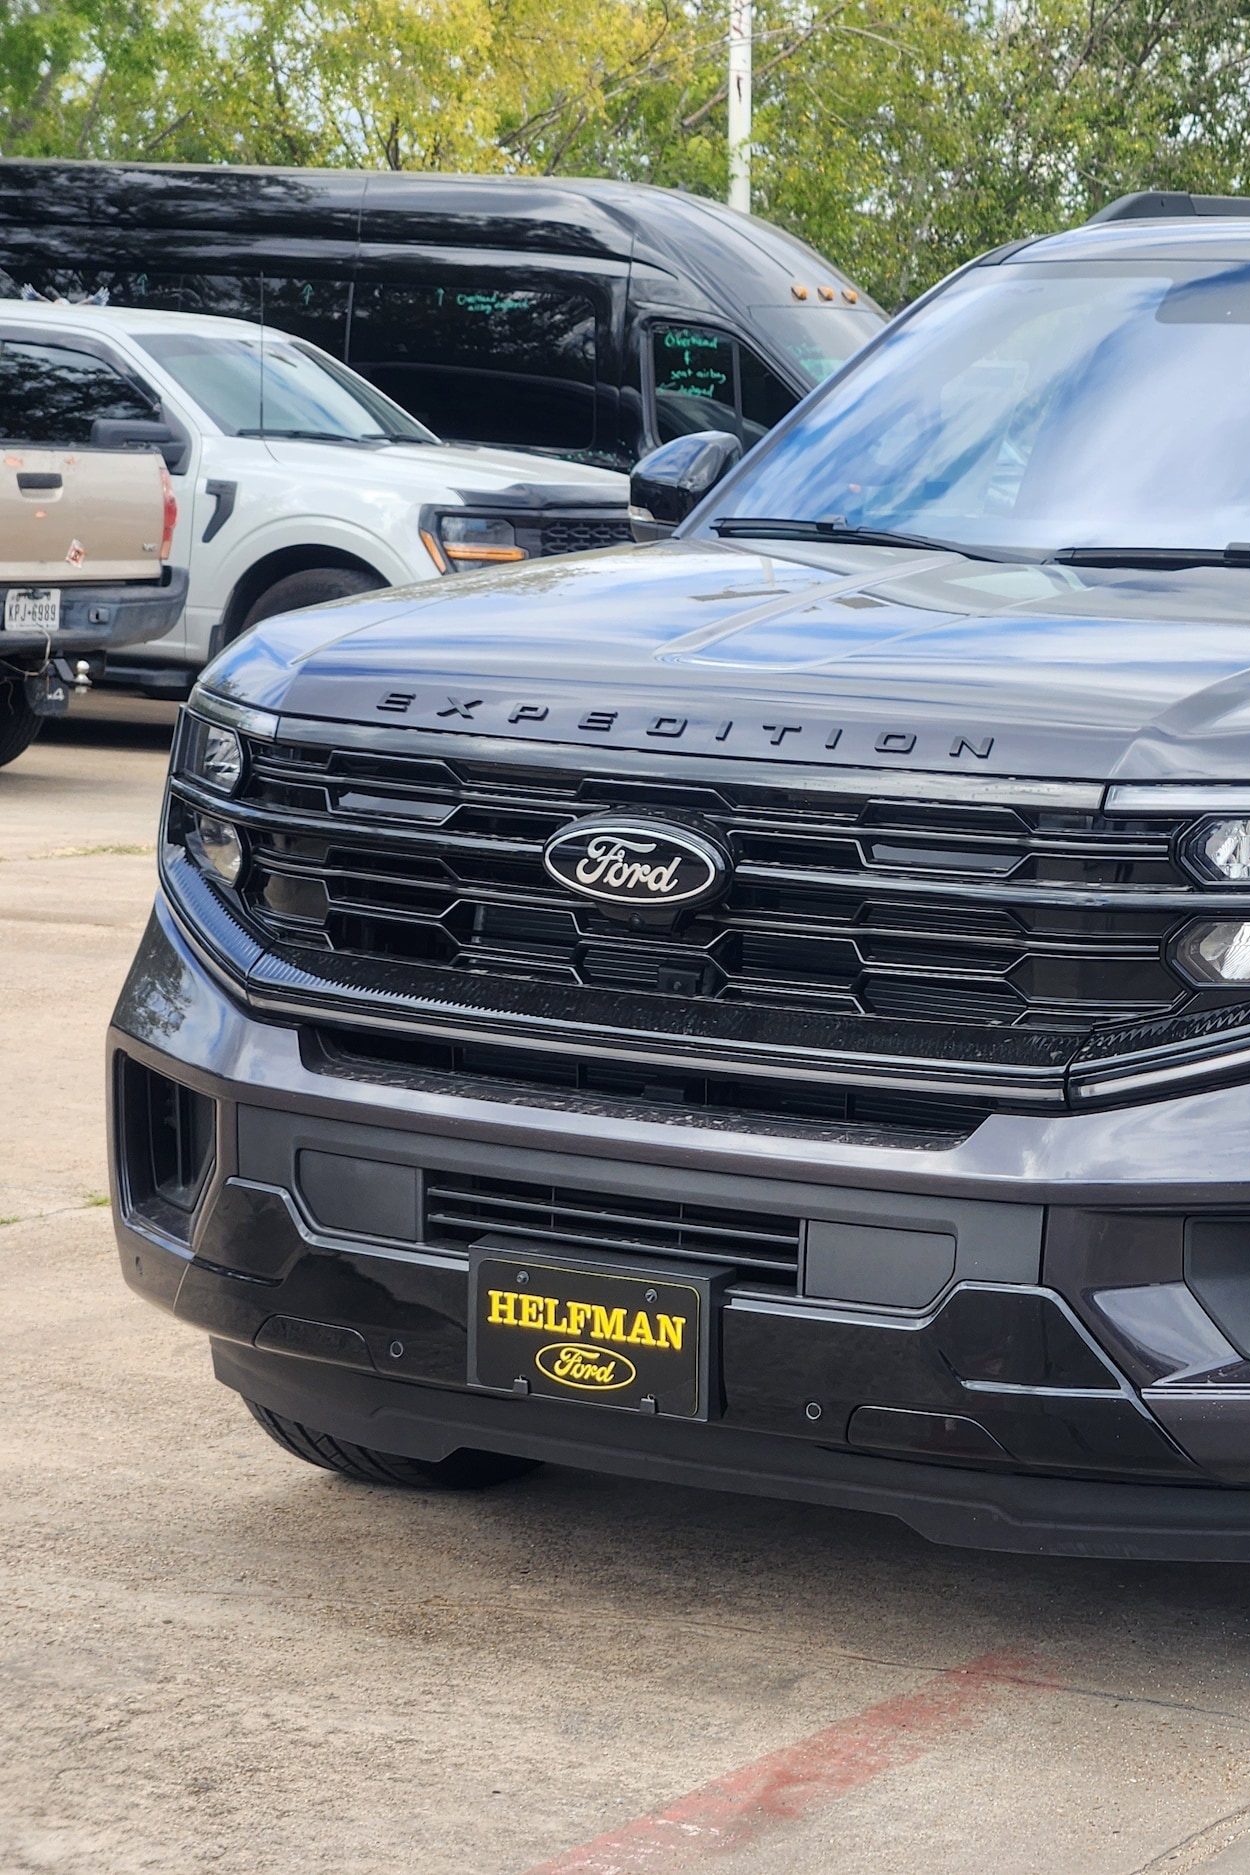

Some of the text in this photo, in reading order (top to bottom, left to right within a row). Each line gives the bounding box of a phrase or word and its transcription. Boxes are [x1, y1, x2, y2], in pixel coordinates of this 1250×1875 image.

[376, 691, 995, 760] EXPEDITION
[575, 835, 682, 895] Ford
[486, 1289, 687, 1351] HELFMAN
[553, 1346, 617, 1384] Ford
